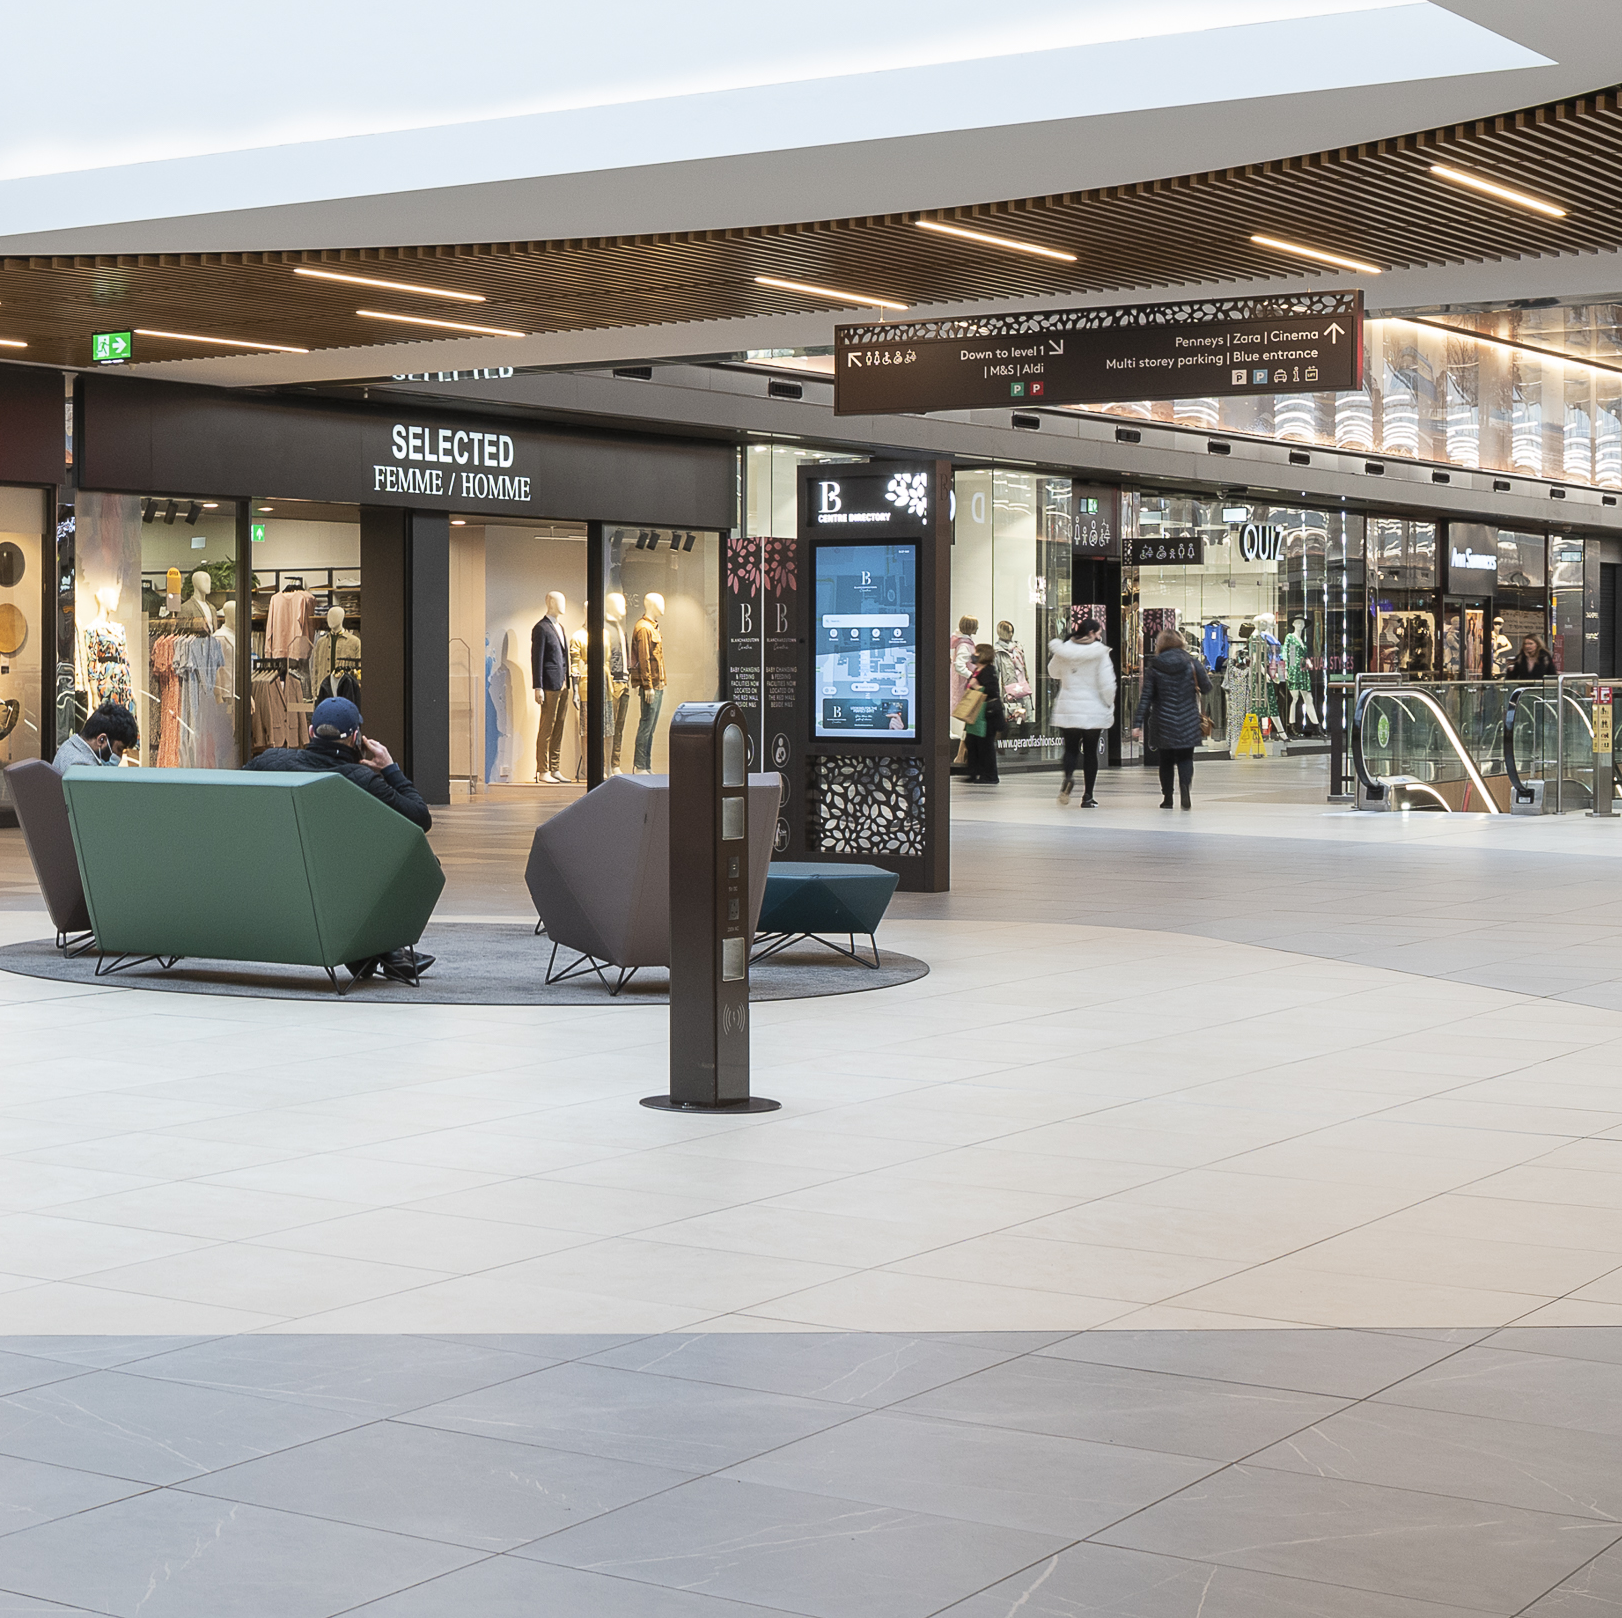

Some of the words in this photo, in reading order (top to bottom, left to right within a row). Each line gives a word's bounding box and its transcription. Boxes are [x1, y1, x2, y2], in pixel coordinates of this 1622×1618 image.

[960, 349, 993, 361] Down
[995, 348, 1008, 359] to
[1011, 346, 1037, 358] level
[1039, 346, 1045, 356] 1
[1175, 335, 1224, 348] Penneys
[1233, 333, 1261, 345] Zara
[1270, 330, 1319, 342] Cinema
[990, 364, 1014, 376] M&S
[1022, 363, 1045, 374] Aldi
[1106, 357, 1136, 370] Multi
[1139, 356, 1175, 369] storey
[1177, 353, 1224, 369] parking
[1233, 351, 1260, 363] Blue
[1262, 348, 1319, 361] entrance
[391, 424, 514, 468] SELECTED
[373, 465, 444, 496] FEMME
[461, 472, 531, 502] HOMME
[818, 481, 842, 513] B
[818, 513, 848, 523] CENTRE
[848, 512, 891, 523] DIRECTORY
[1242, 523, 1285, 561] QUIZ
[739, 603, 752, 633] B
[775, 603, 788, 633] B
